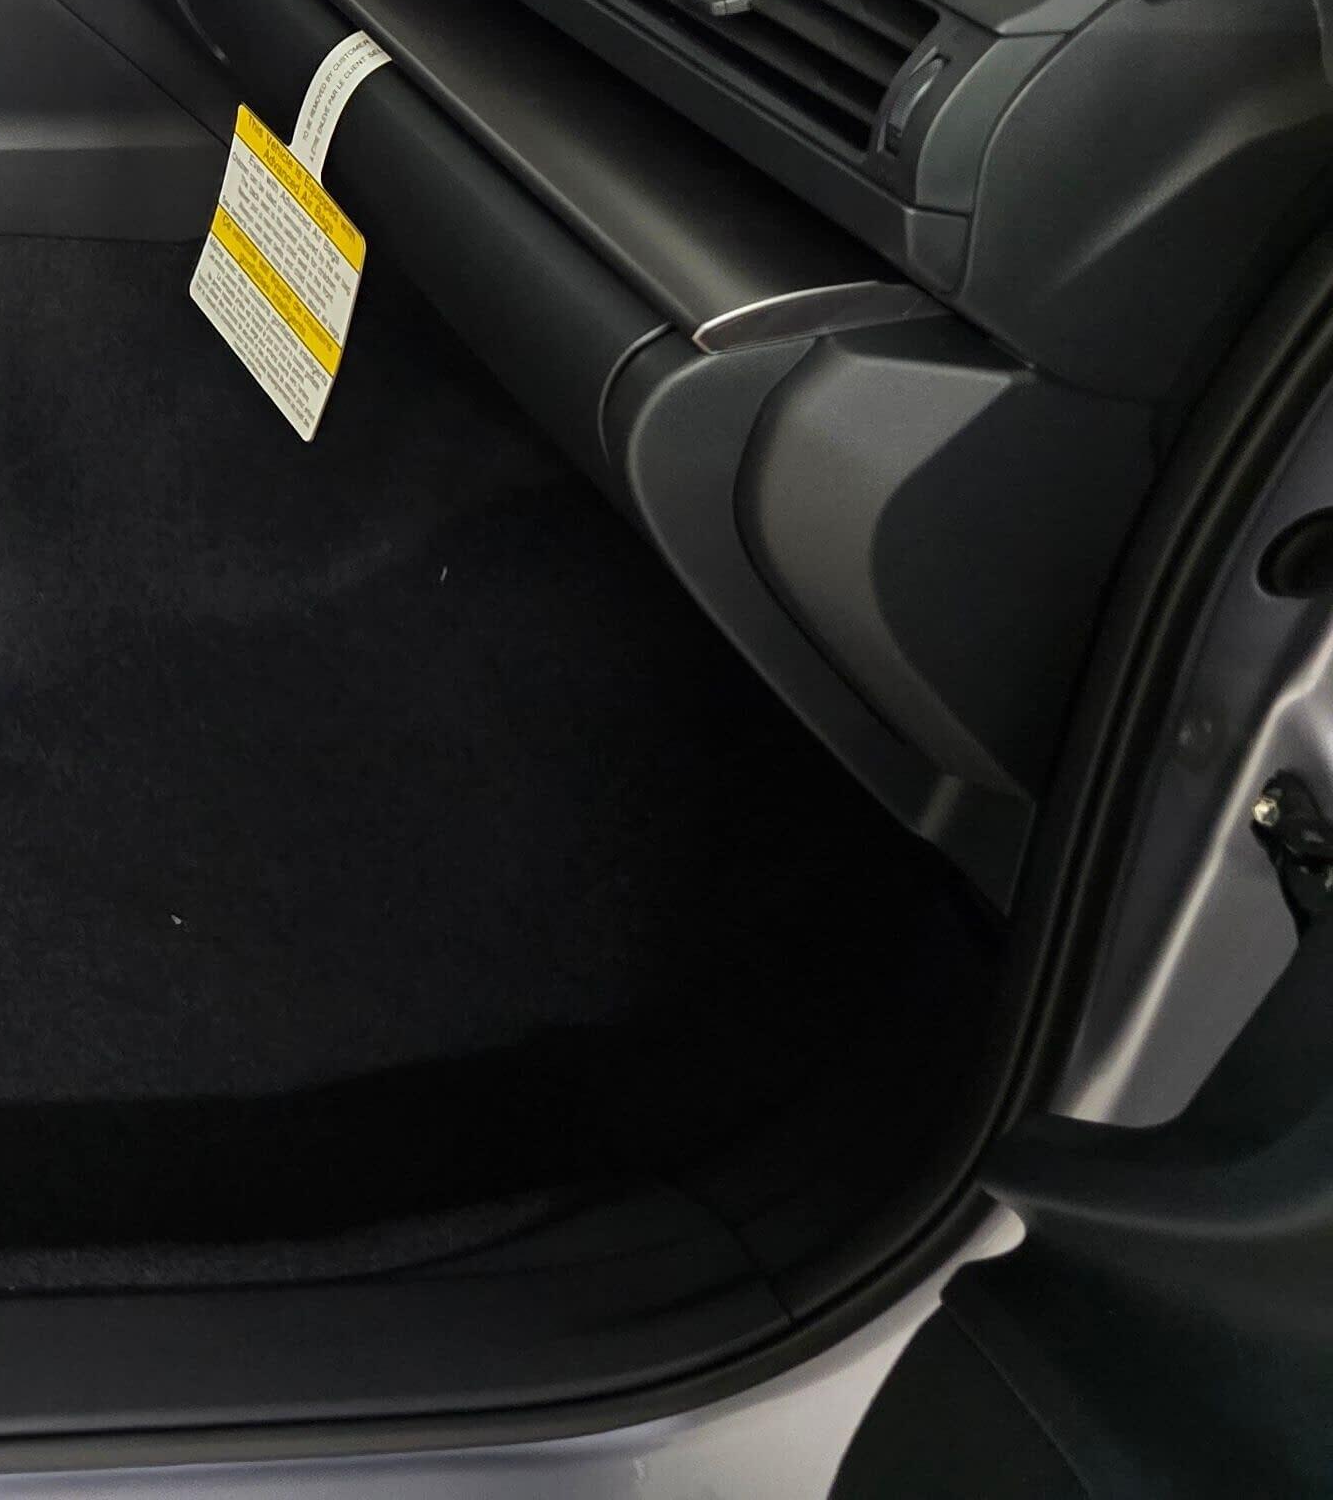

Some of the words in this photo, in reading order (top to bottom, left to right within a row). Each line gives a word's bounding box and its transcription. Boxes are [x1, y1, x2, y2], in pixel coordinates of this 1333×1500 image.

[310, 83, 327, 118] REMOVED
[326, 71, 333, 83] BY
[333, 40, 370, 71] CUSTOMER
[343, 57, 366, 79] CLIENT
[248, 116, 263, 139] This
[264, 133, 293, 170] Vehicle
[294, 165, 303, 181] is
[302, 174, 340, 224] Equipped
[339, 219, 356, 243] with
[248, 153, 265, 178] Even
[265, 174, 279, 194] with
[279, 188, 312, 232] Advanced
[311, 225, 322, 243] Air
[321, 238, 340, 267] Bags
[262, 145, 300, 196] Advanced
[300, 189, 313, 210] Air
[313, 203, 335, 239] Bags
